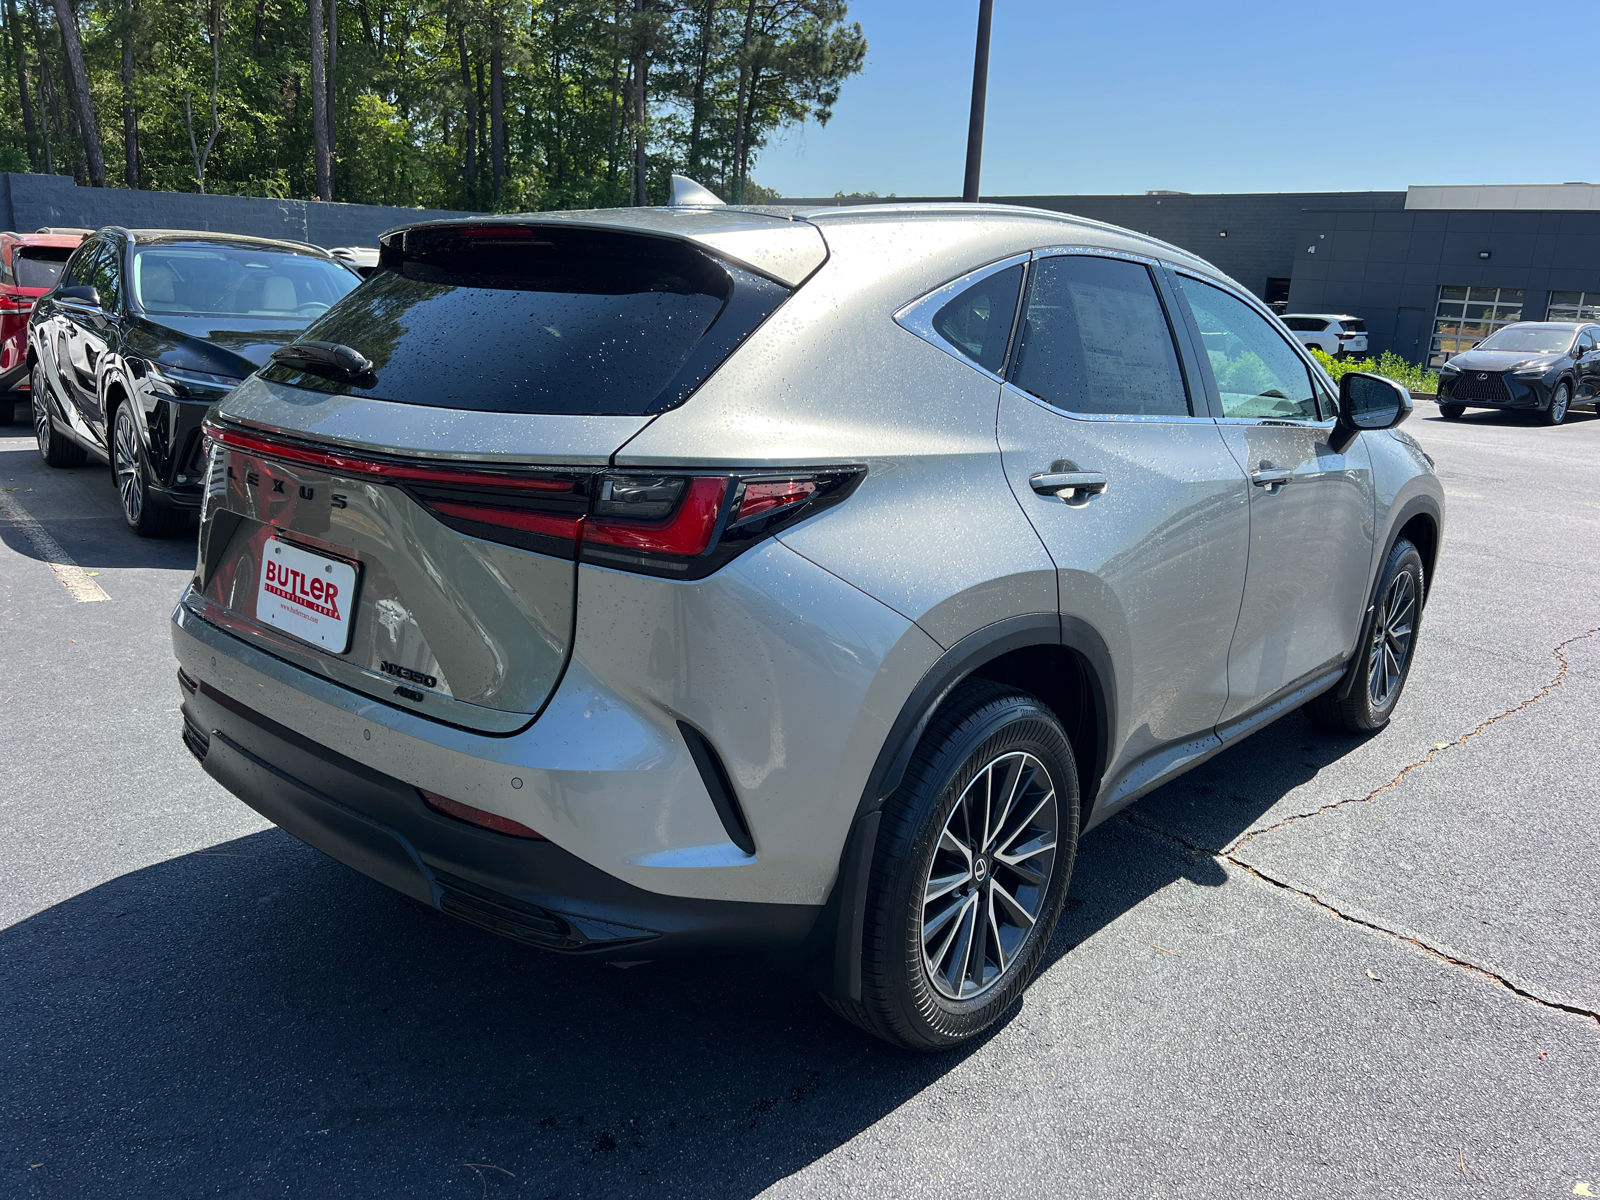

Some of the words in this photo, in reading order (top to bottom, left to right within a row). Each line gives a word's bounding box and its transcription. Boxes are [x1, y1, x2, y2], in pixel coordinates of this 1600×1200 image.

[227, 466, 348, 510] LEXUS
[313, 603, 338, 619] GROUP
[380, 660, 437, 688] NX350
[392, 686, 424, 702] AWD
